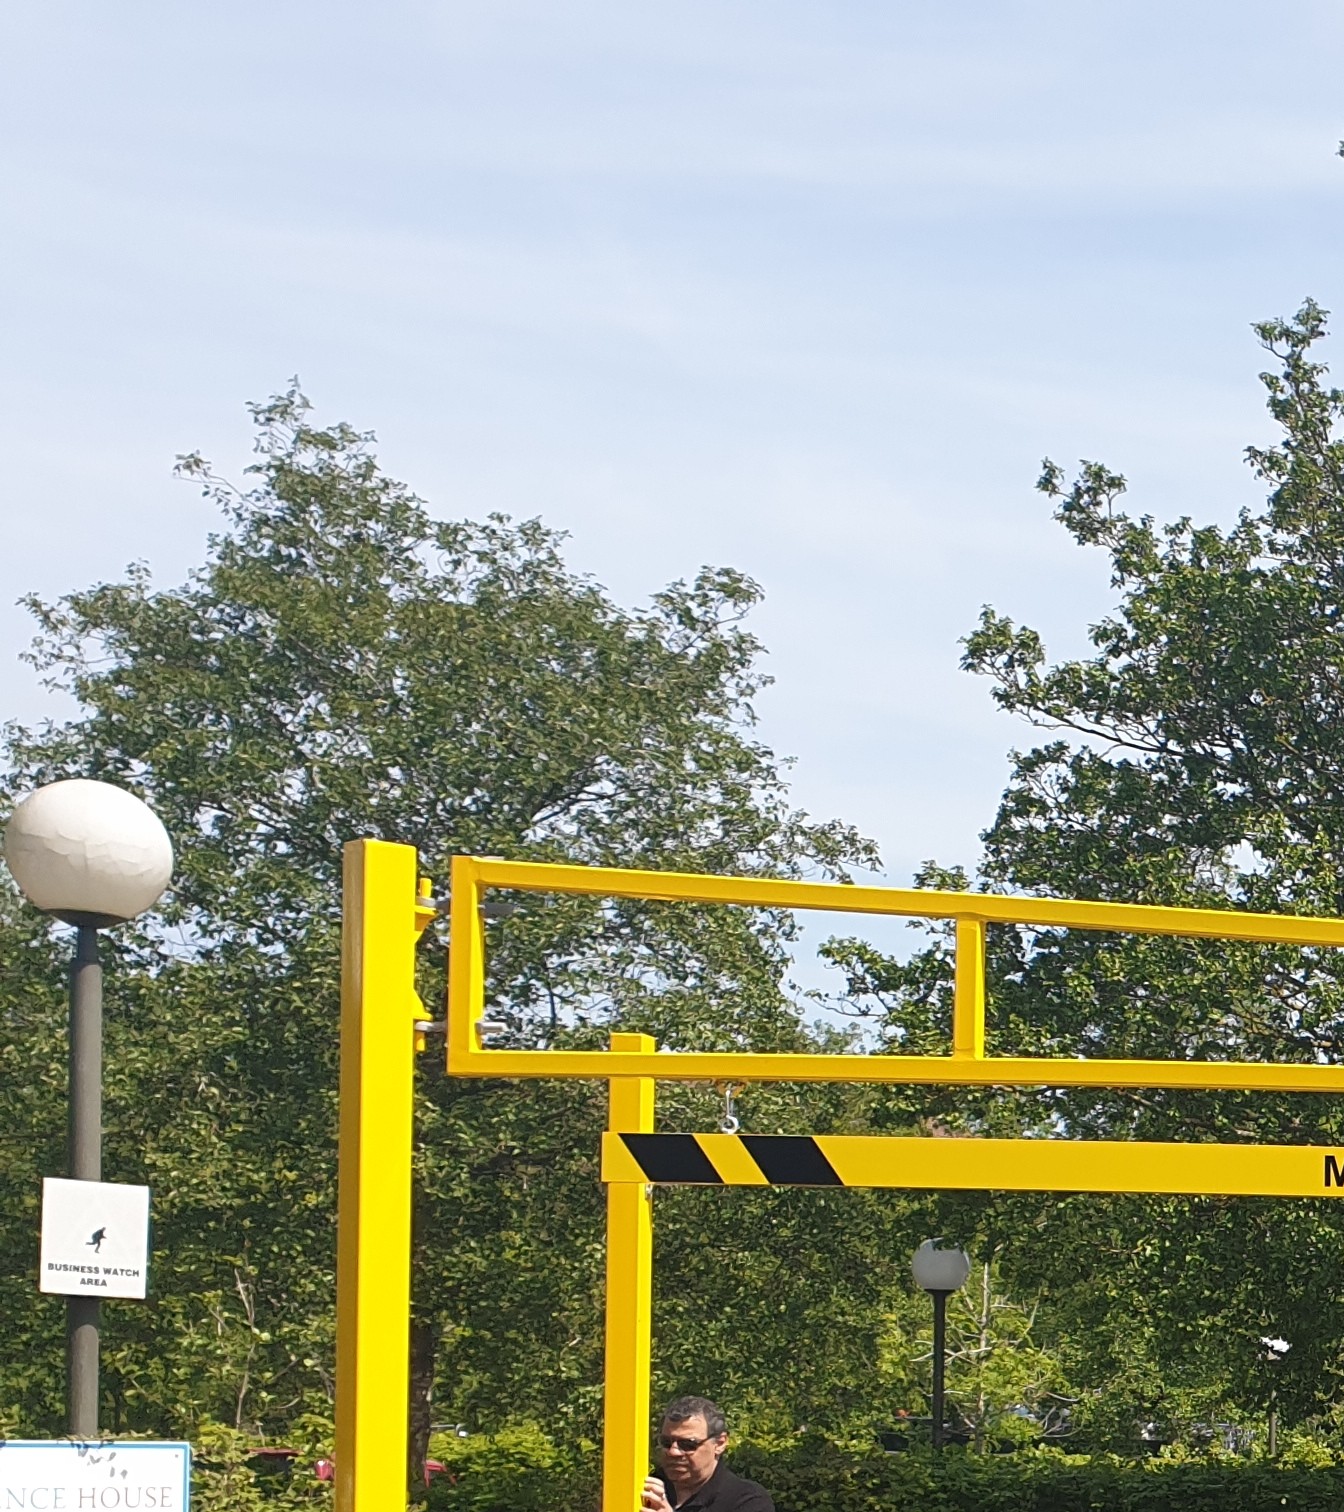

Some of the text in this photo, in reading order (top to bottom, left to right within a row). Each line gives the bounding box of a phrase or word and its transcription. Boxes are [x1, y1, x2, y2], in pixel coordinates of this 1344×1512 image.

[47, 1263, 139, 1277] BUSINESS WATCH
[79, 1278, 107, 1287] AREA
[0, 1486, 173, 1510] NCE HOUSE
